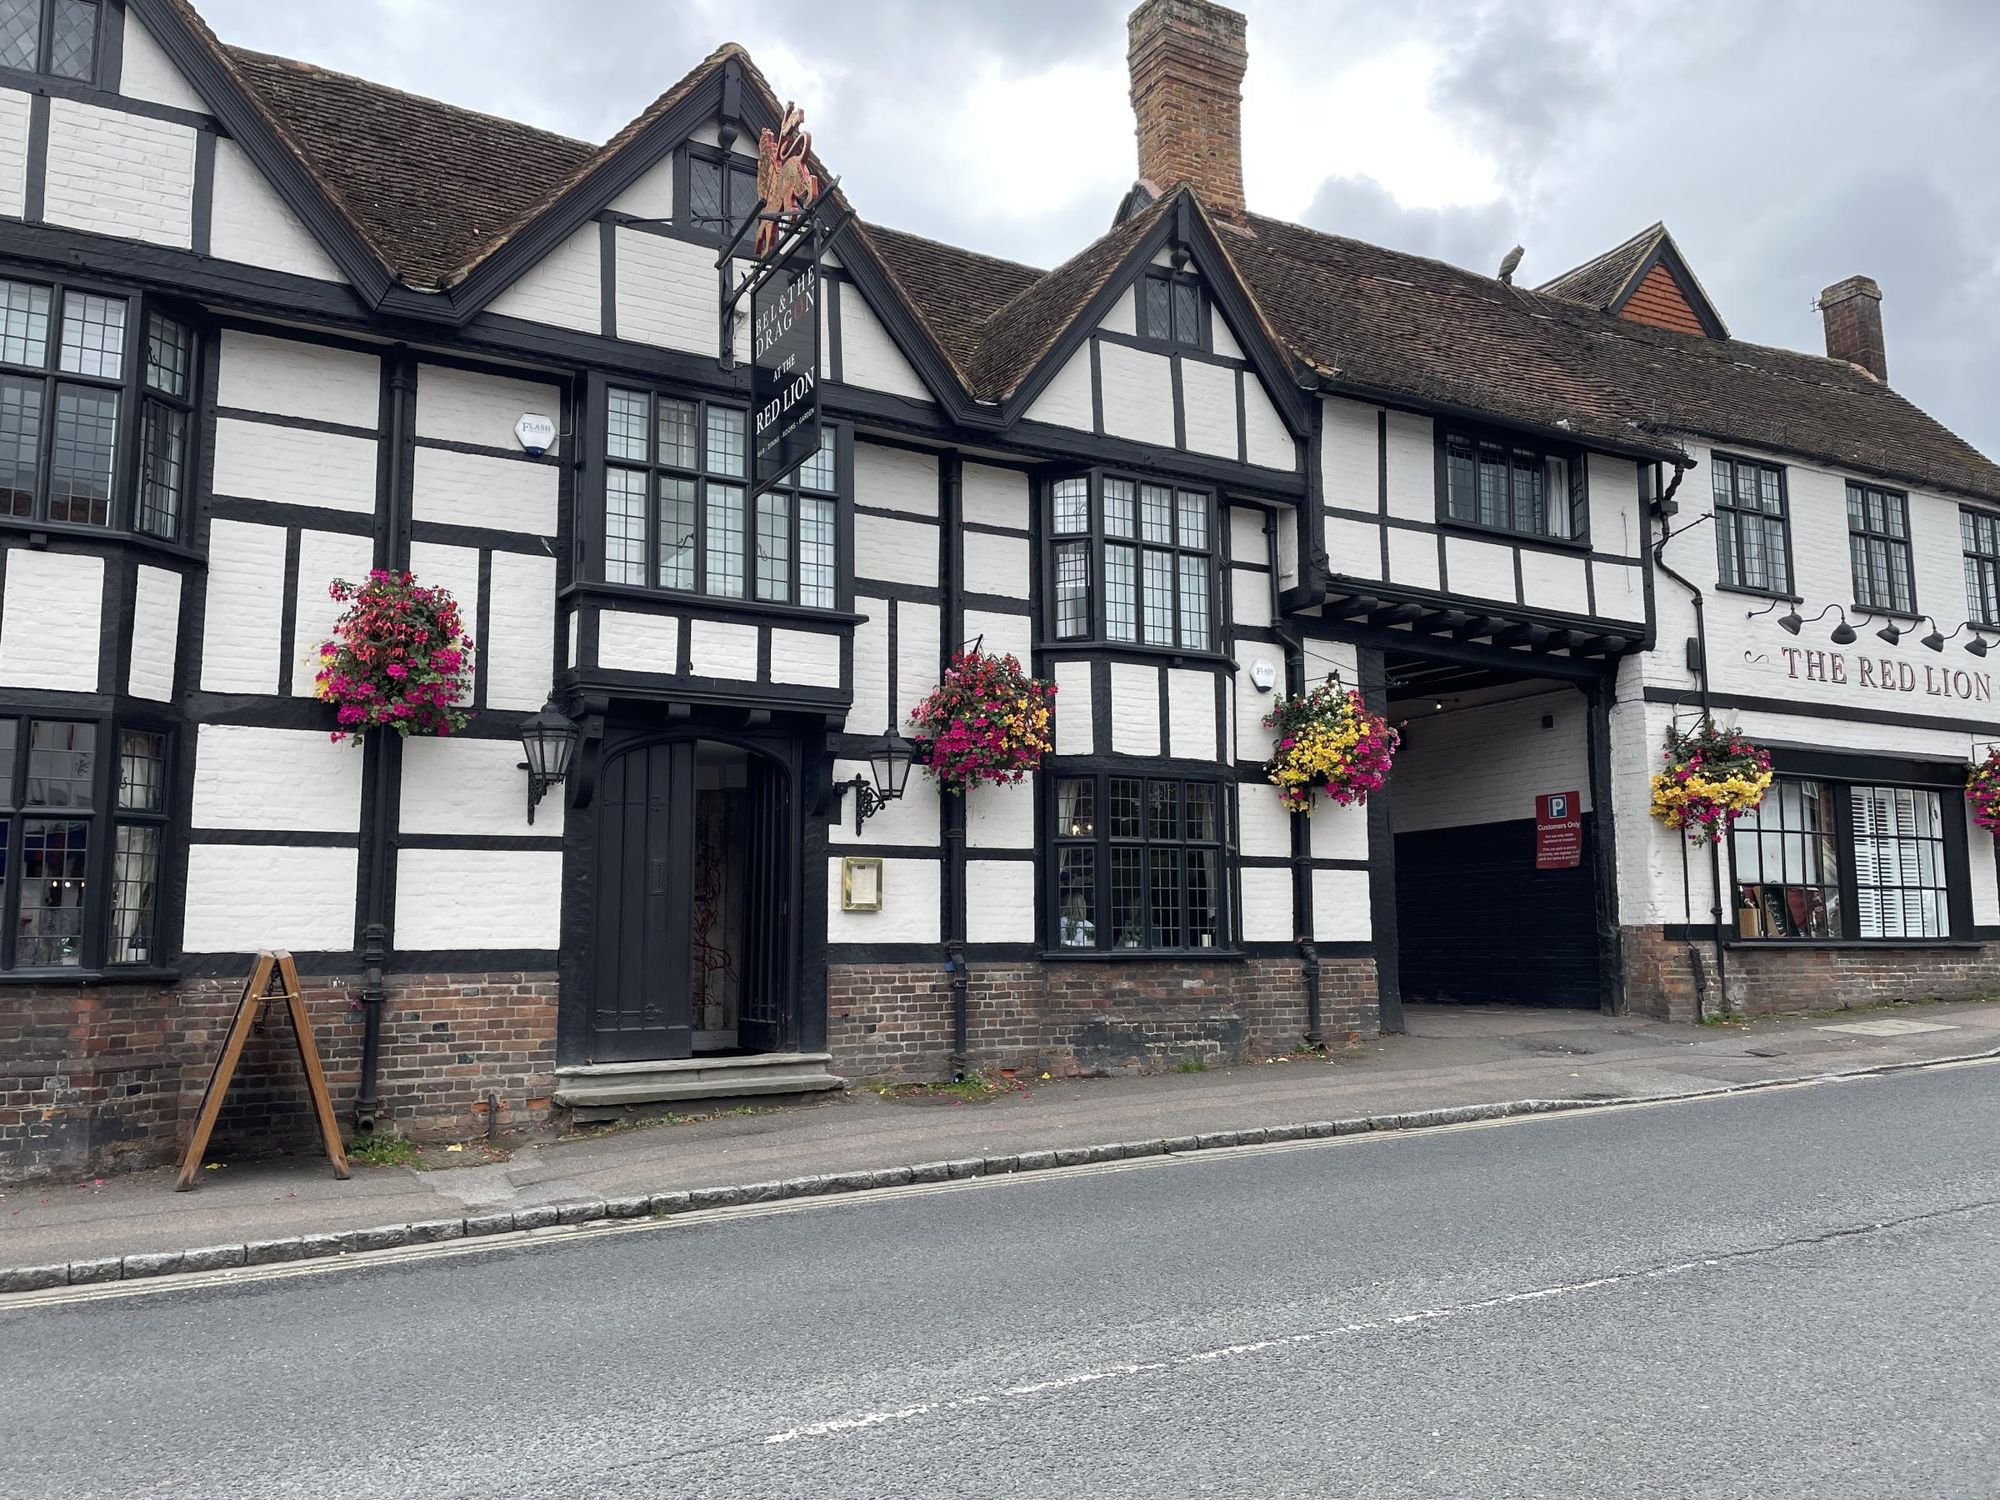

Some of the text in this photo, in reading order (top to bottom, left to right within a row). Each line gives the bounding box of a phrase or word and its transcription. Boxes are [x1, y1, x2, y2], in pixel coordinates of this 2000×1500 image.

[755, 264, 815, 337] BEL & THE
[755, 285, 815, 360] DRAGON
[773, 353, 796, 383] AT THE
[756, 365, 815, 435] RED LION
[1781, 646, 1991, 702] THE RED LION
[1537, 821, 1580, 831] Customers Only
[1552, 798, 1564, 816] P
